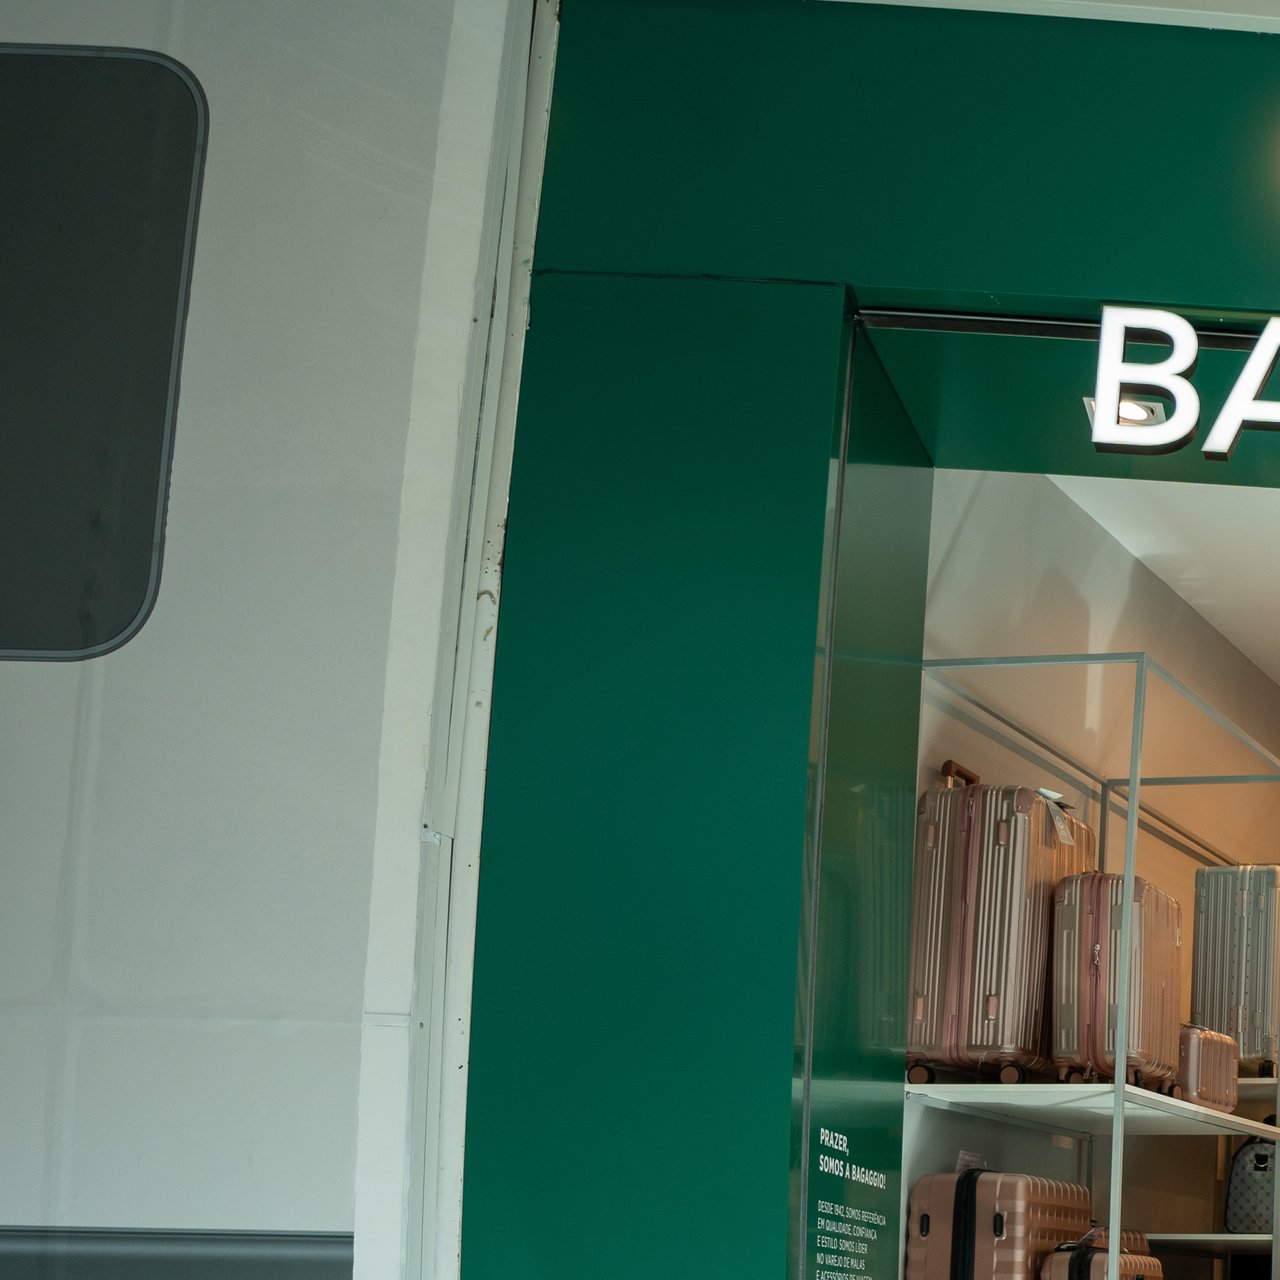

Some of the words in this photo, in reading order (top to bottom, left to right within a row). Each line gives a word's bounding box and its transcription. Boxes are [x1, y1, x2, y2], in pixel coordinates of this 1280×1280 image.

[820, 1128, 849, 1156] PRAZER,
[819, 1154, 844, 1177] SOMOS
[845, 1162, 850, 1179] A
[852, 1164, 886, 1189] BAGAGGIO!
[818, 1200, 833, 1214] DESDE
[846, 1206, 861, 1220] SOMOS
[862, 1210, 886, 1226] REFERÊNCIA
[818, 1217, 825, 1229] EM
[839, 1239, 855, 1252] SOMOS
[816, 1252, 824, 1265] NO
[825, 1253, 843, 1267] VAREJO
[843, 1256, 850, 1268] DE
[851, 1257, 865, 1270] MALAS
